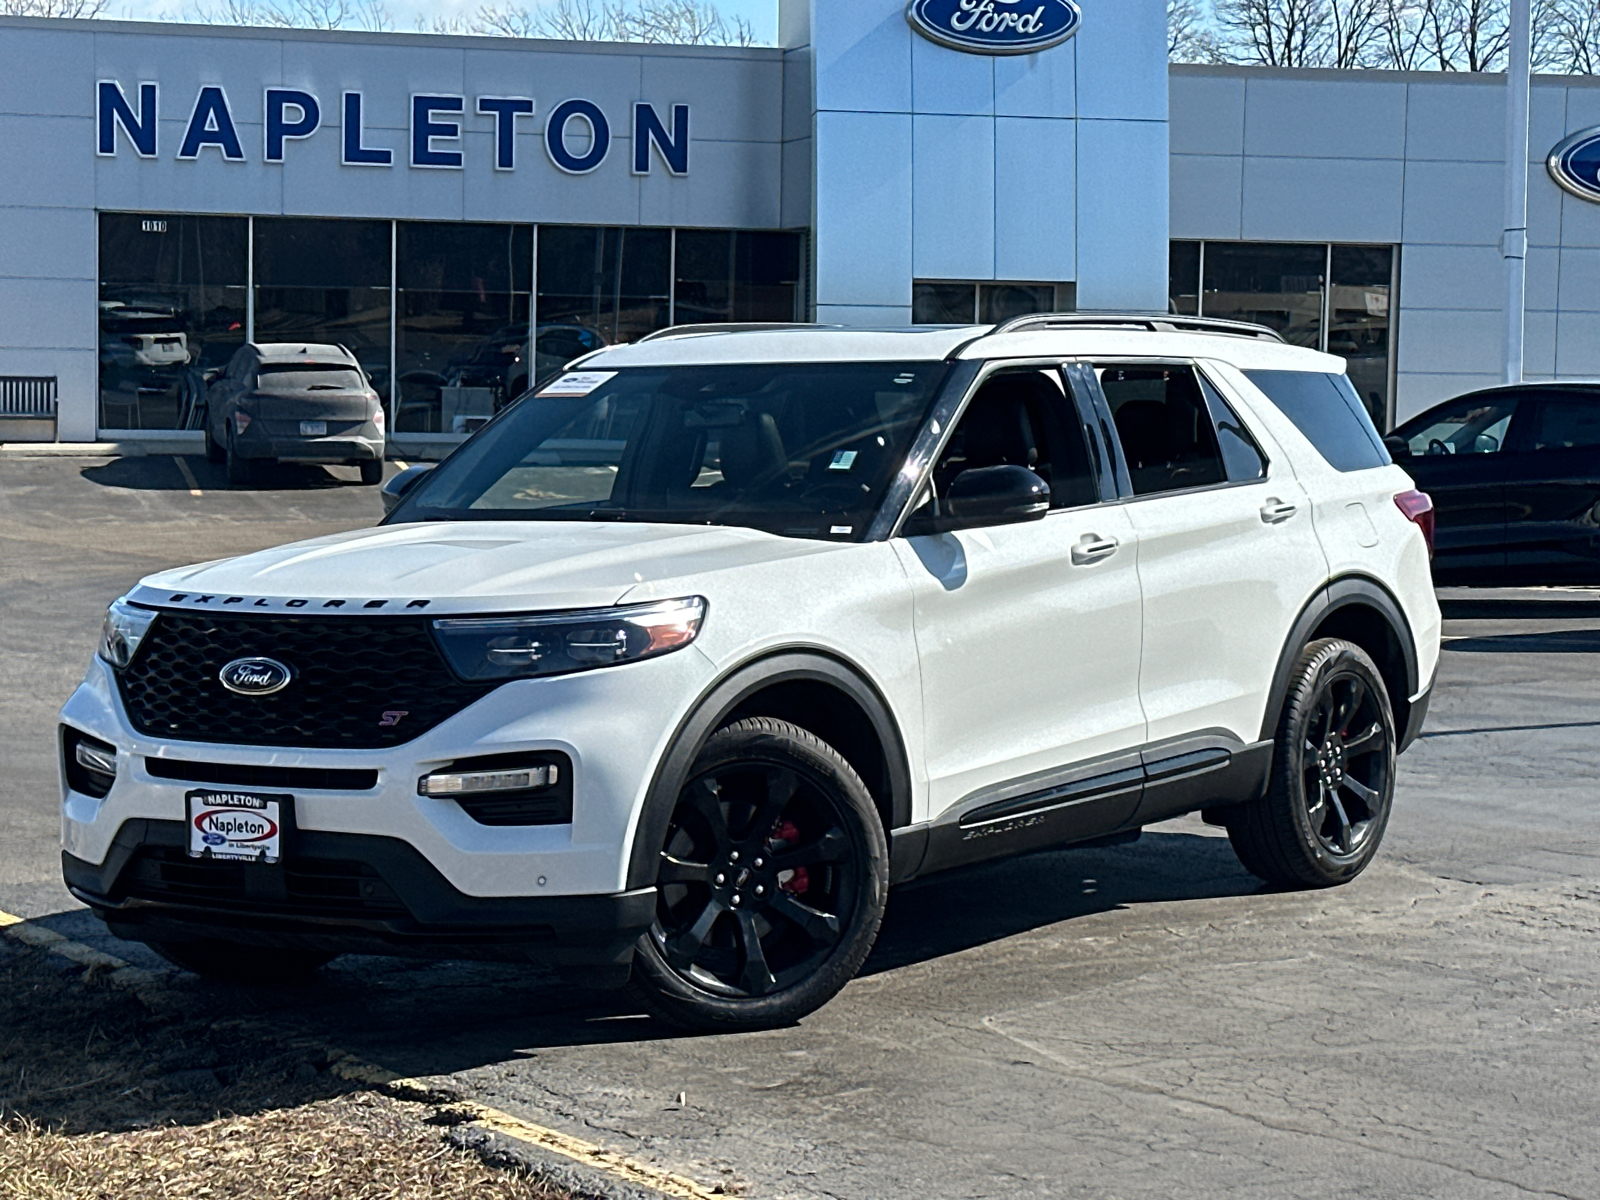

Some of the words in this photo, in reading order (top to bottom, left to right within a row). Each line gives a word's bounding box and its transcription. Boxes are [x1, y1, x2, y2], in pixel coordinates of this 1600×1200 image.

[950, 0, 1045, 34] Ford
[96, 79, 690, 176] NAPLETON
[142, 220, 167, 232] 1010
[169, 594, 431, 609] EXPLORER
[233, 664, 273, 686] Ford
[378, 710, 409, 726] ST
[207, 794, 260, 808] NAPLETON
[208, 815, 264, 836] Napleton
